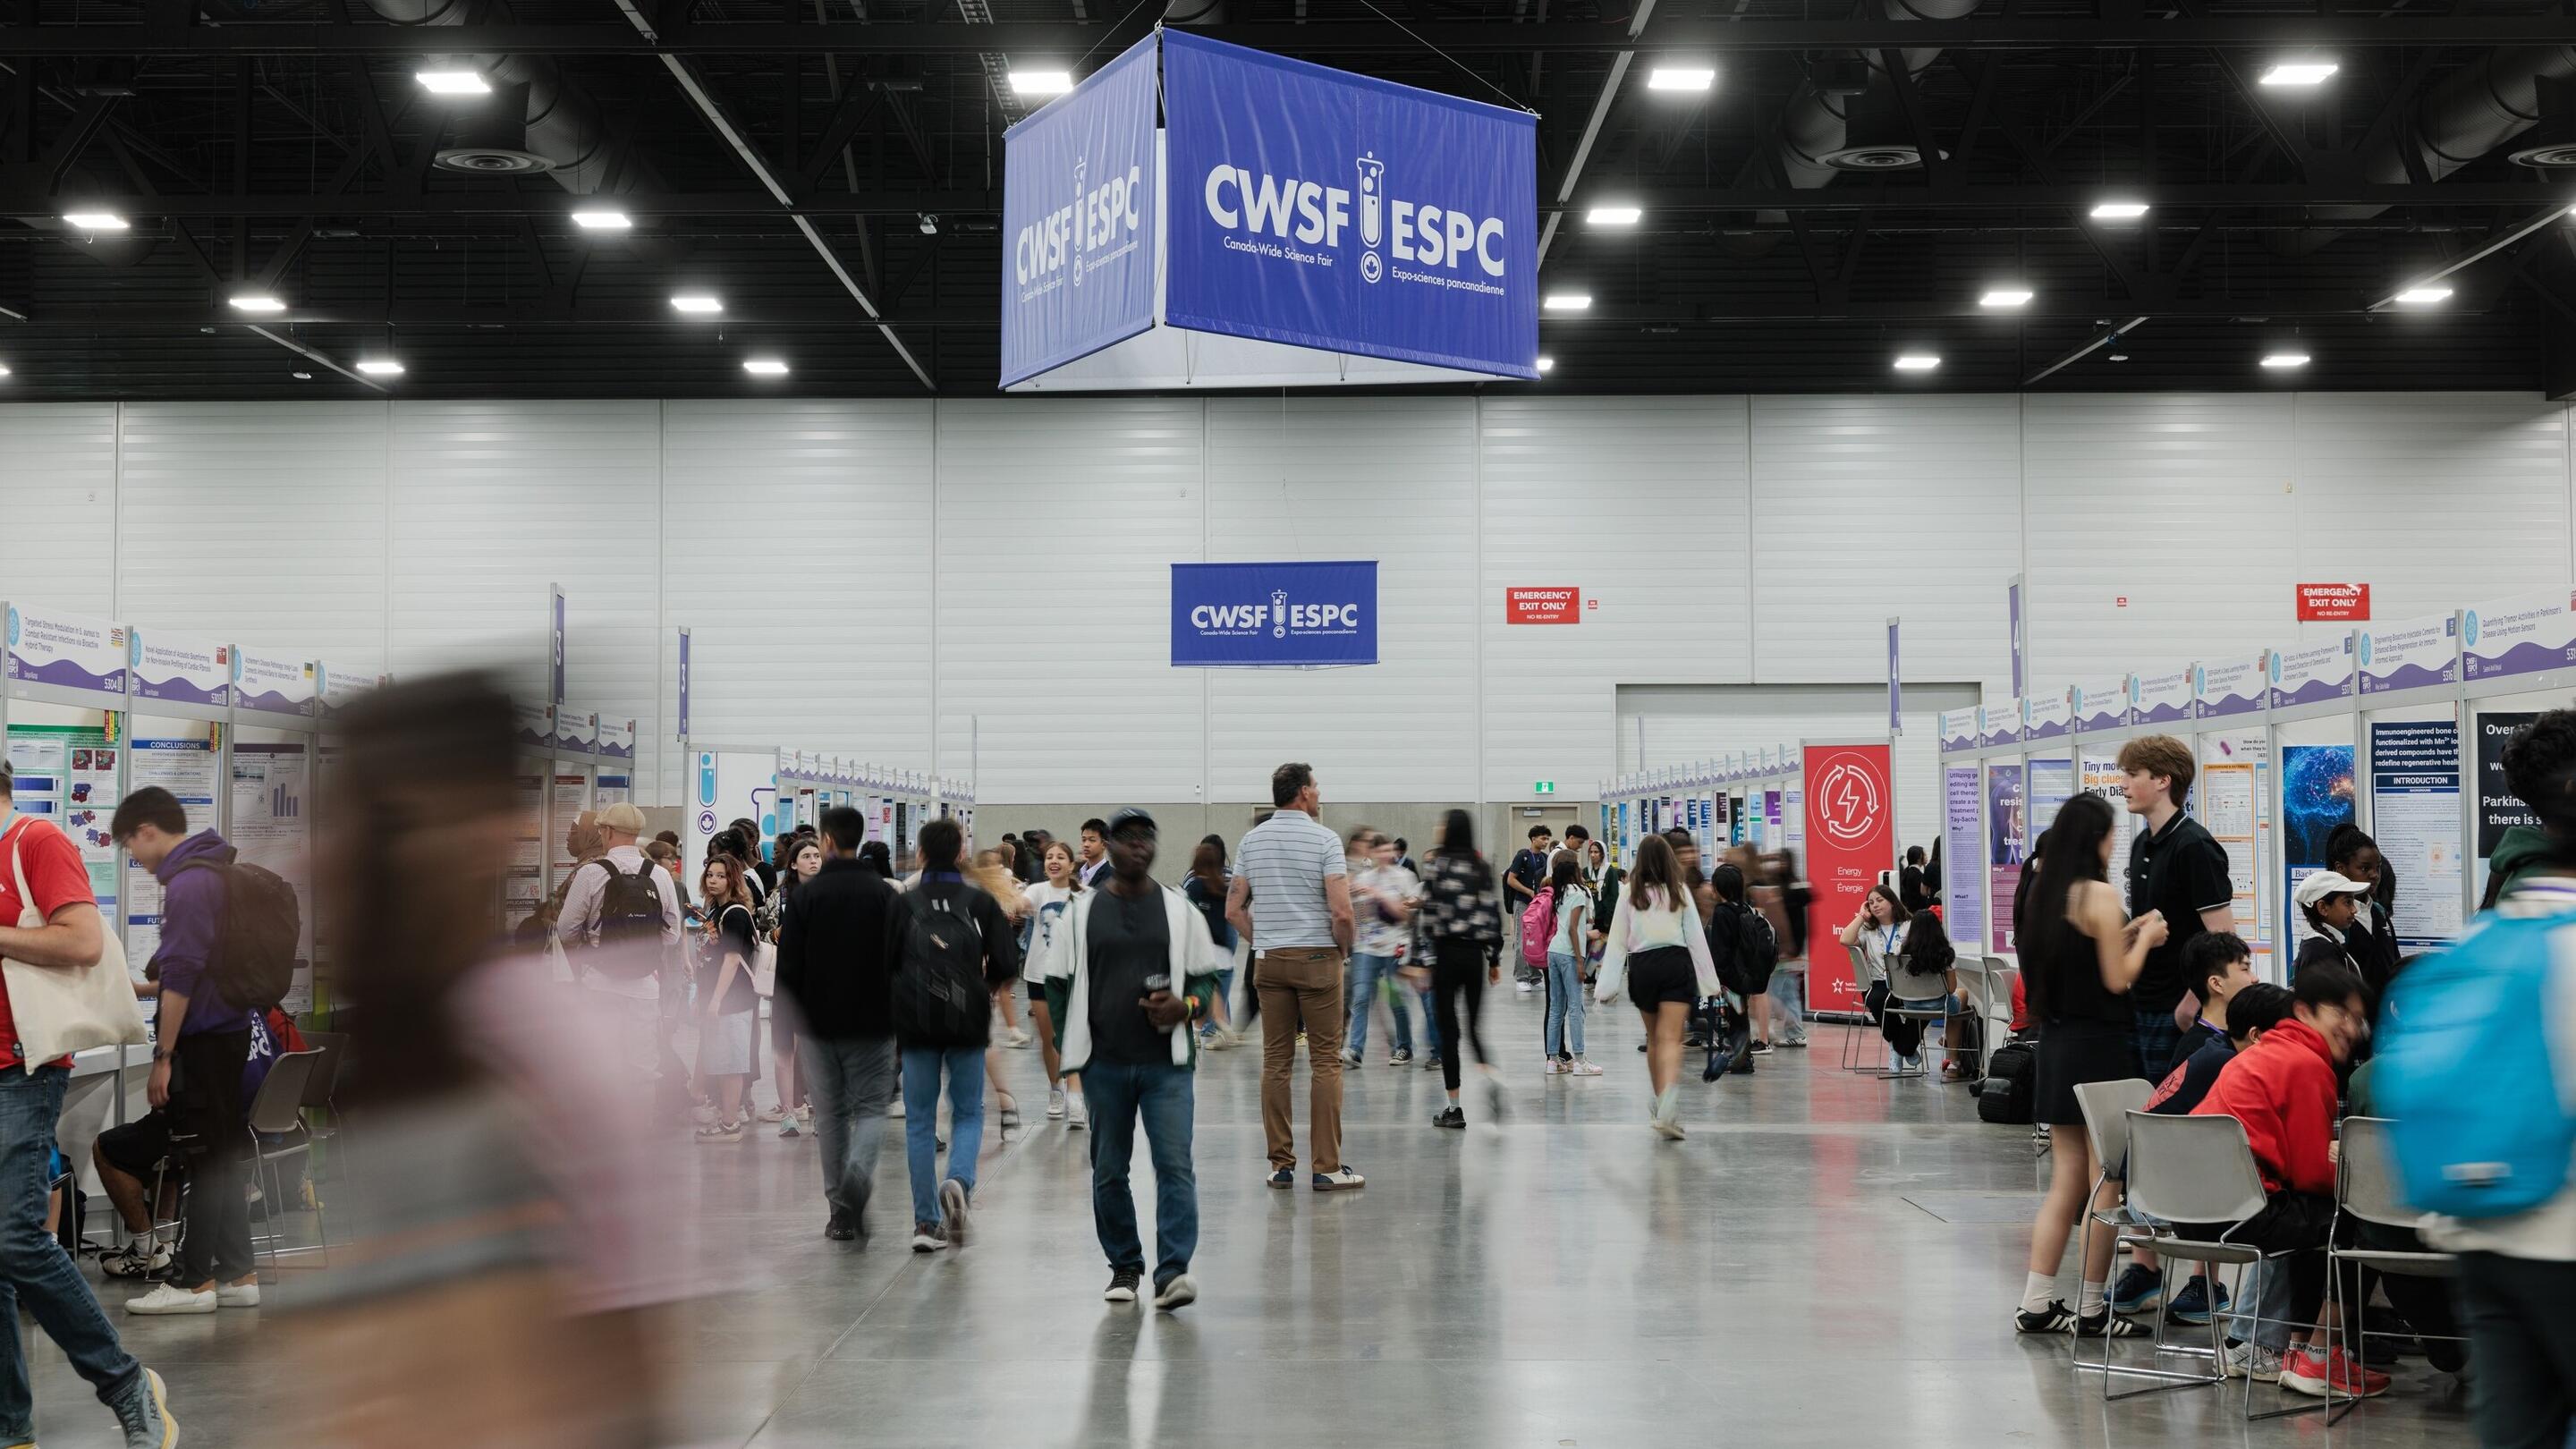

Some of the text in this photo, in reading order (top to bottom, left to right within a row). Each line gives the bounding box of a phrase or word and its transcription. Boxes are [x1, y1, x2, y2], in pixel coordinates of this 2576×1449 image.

[1016, 166, 1140, 285] CWSF ESPC
[1205, 164, 1504, 277] CWSF ESPC
[1224, 236, 1333, 267] Canada-Wide Science Fair
[1392, 267, 1504, 296] Expo-sciences pancanadienne
[1513, 591, 1572, 599] EMERGENCY
[2303, 588, 2362, 597] EMERGENCY
[1519, 602, 1567, 610] EXIT ONLY
[2309, 598, 2357, 606] EXIT ONLY
[1191, 603, 1358, 629] CWSF ESPC
[2483, 617, 2504, 628] Quantifying
[2504, 614, 2518, 623] Tremor
[2518, 612, 2536, 621] Activities
[2540, 607, 2562, 617] Parkinson's
[25, 617, 42, 629] Targeted
[43, 620, 54, 630] Stress
[55, 623, 75, 634] Modulation
[2483, 623, 2536, 639] Disease Using Motion Sensors
[25, 628, 40, 639] Combat
[40, 631, 57, 641] Resistant
[58, 634, 76, 645] Infections
[82, 639, 98, 649] Bioactive
[2013, 620, 2020, 656] 4
[38, 642, 54, 654] Therapy
[1892, 655, 1898, 685] 4
[104, 678, 117, 690] 5304
[2376, 727, 2434, 736] Immunoengineered
[2486, 724, 2514, 734] Over
[150, 741, 200, 750] CONCLUSIONS
[2376, 738, 2419, 746] functionalized
[2399, 748, 2436, 757] compounds
[2084, 761, 2101, 773] Tiny
[2402, 758, 2441, 767] regenerative
[2084, 774, 2098, 785] Big
[2394, 776, 2448, 784] INTRODUCTION
[1950, 816, 1978, 824] Tay-Sachs
[2488, 814, 2521, 825] there
[2523, 814, 2533, 825] is
[1837, 867, 1862, 877] Energy
[1837, 882, 1863, 893] Énergie
